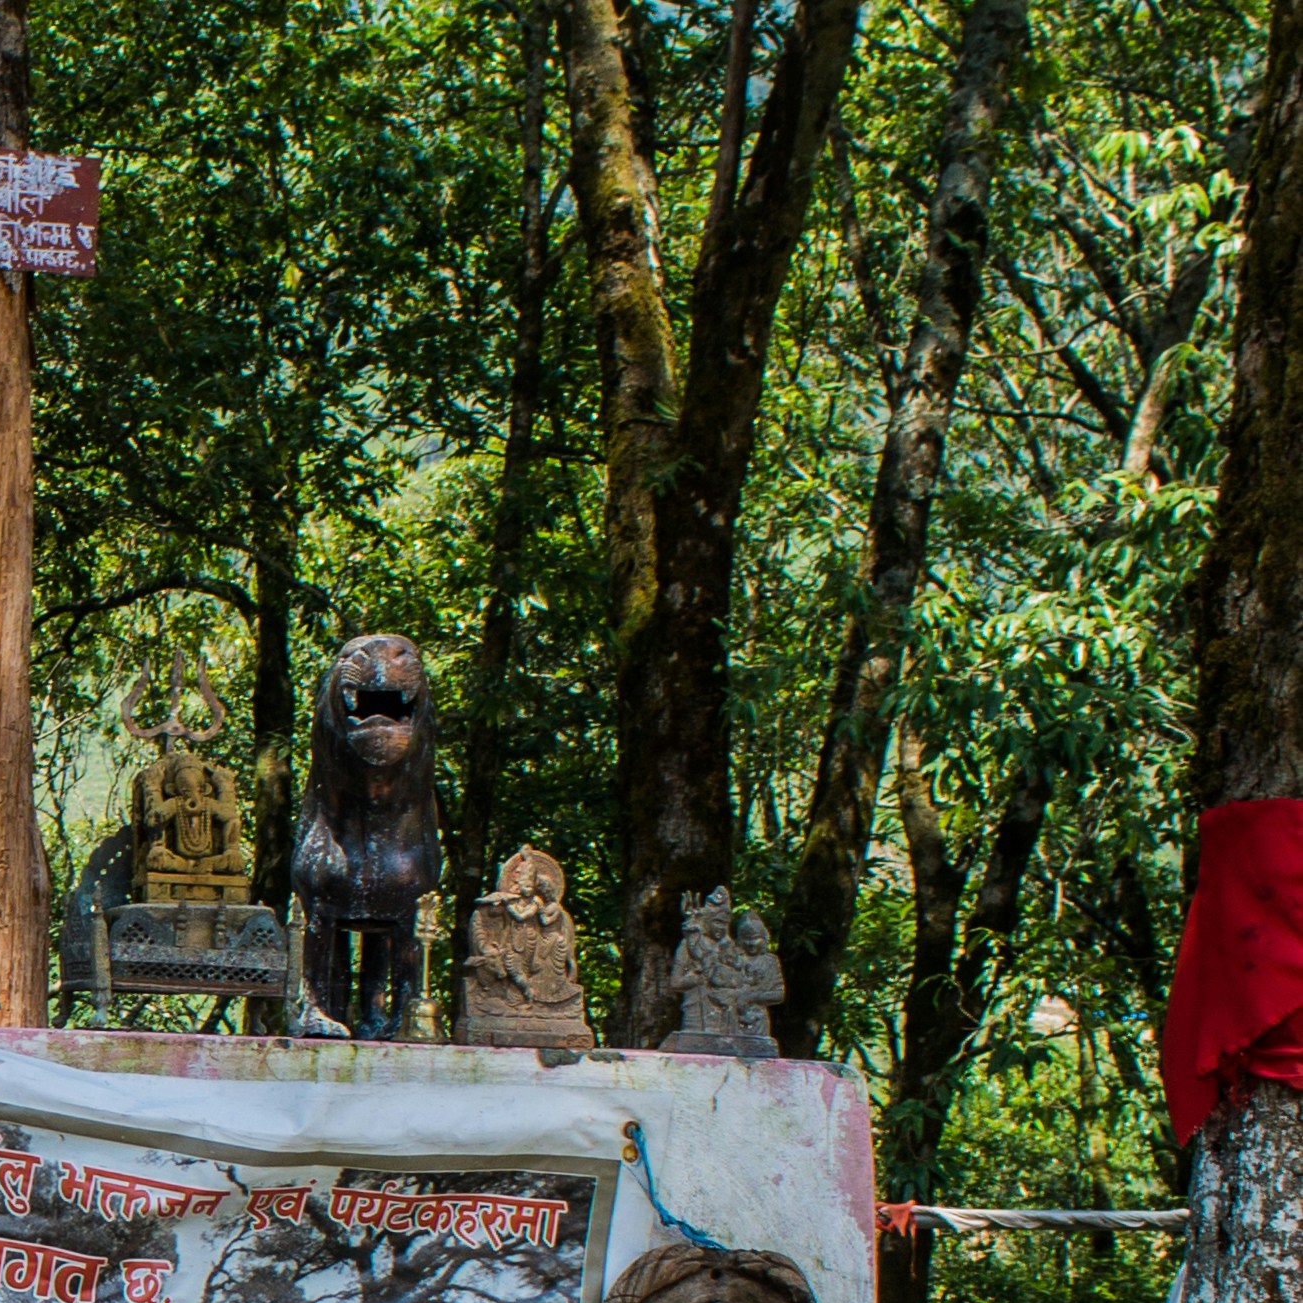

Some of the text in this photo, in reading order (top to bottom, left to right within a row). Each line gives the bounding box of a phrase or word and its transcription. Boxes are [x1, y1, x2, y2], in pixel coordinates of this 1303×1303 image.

[60, 1161, 230, 1221] भक्तजन
[246, 1178, 317, 1231] एवं
[329, 1181, 568, 1249] पर्यटकहरुमा
